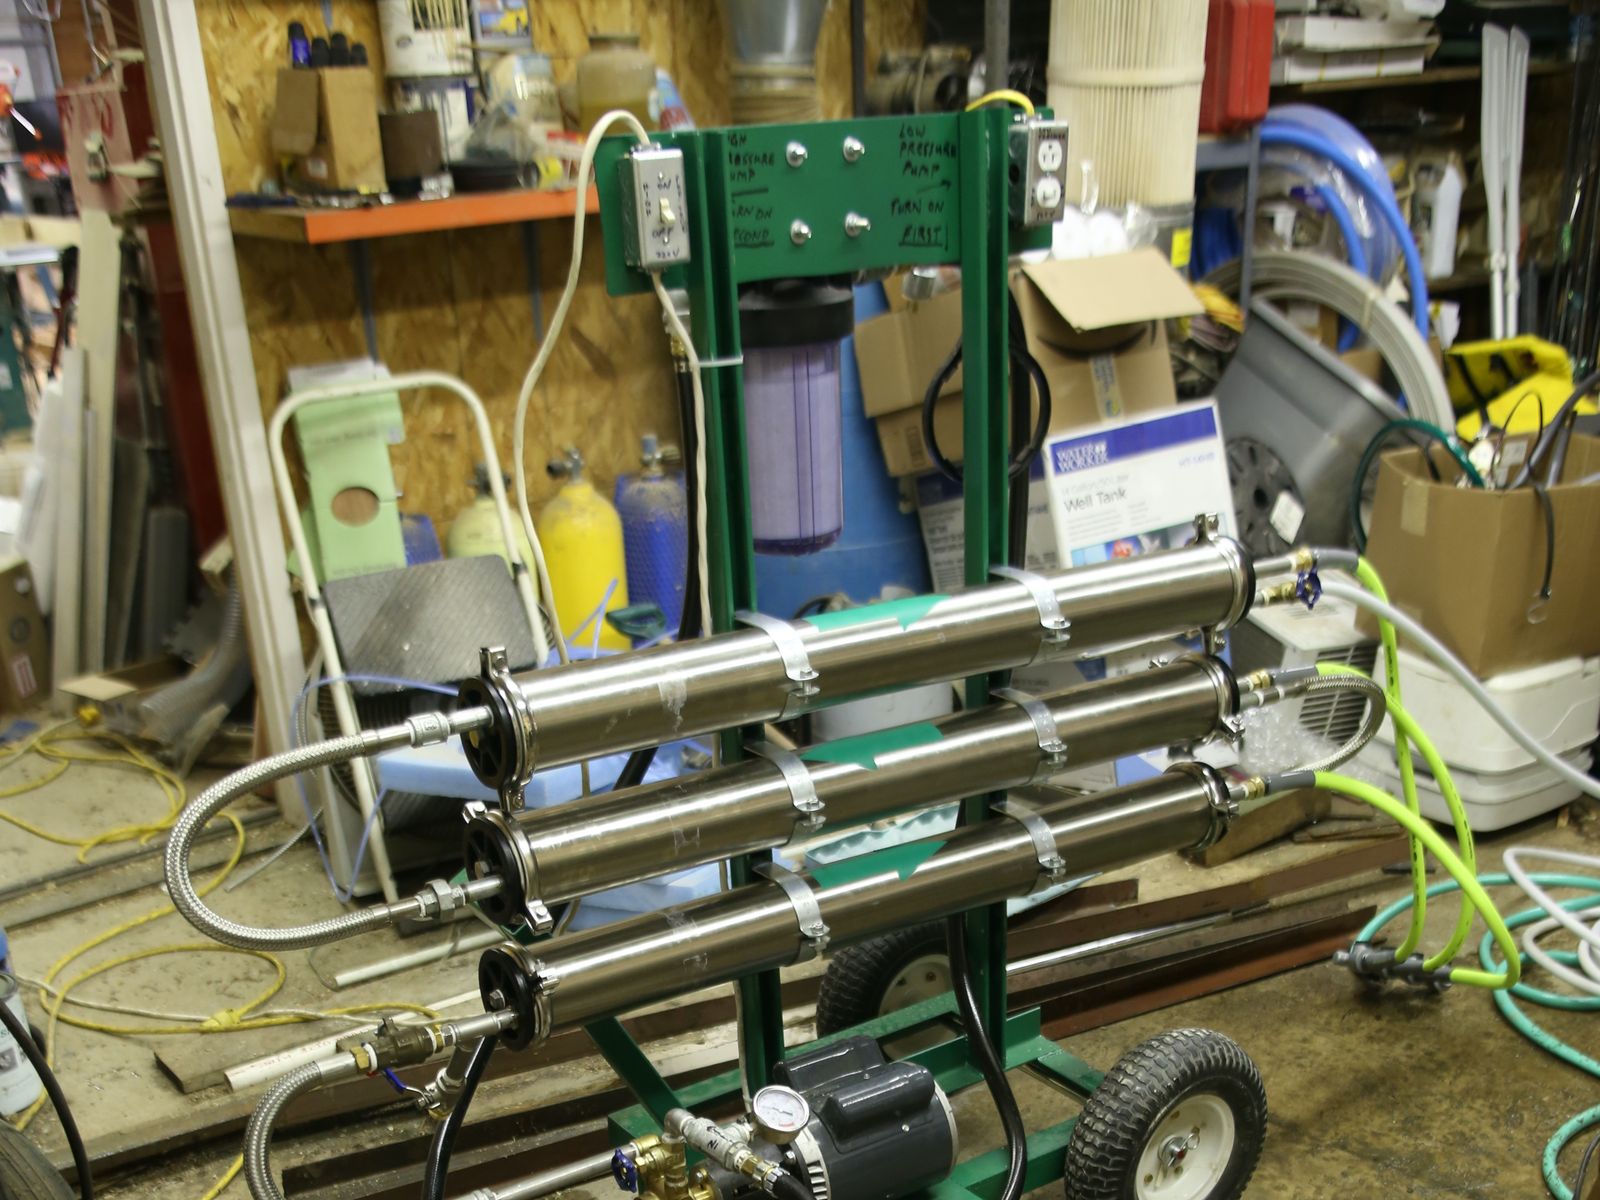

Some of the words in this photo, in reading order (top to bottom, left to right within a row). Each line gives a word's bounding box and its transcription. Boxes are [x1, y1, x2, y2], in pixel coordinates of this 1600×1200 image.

[899, 123, 926, 139] LOW
[727, 132, 747, 147] IGH
[730, 168, 756, 183] UMP
[902, 160, 940, 177] PUMP
[891, 198, 922, 216] TURN
[927, 200, 945, 213] ON
[734, 227, 769, 242] ECOND
[1064, 495, 1093, 513] Well
[1095, 487, 1127, 505] Tank
